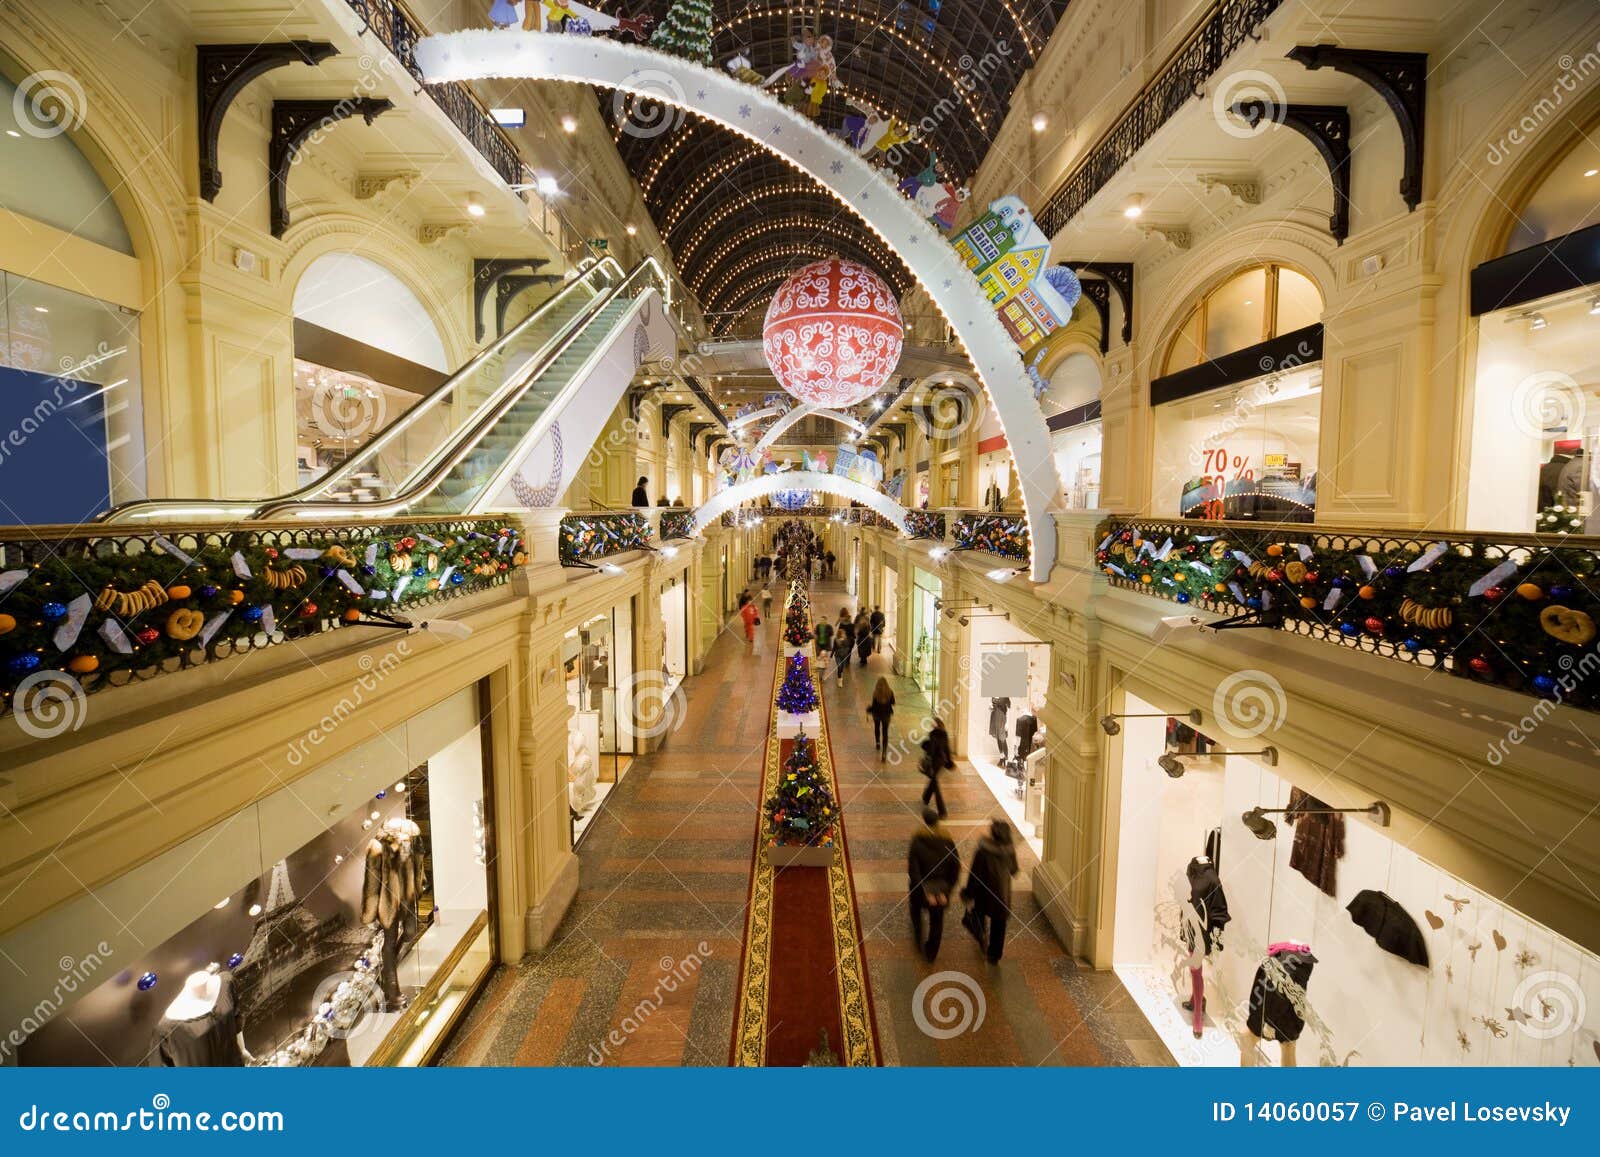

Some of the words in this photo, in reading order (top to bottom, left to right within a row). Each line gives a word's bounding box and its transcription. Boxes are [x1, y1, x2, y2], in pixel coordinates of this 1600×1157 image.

[1203, 449, 1227, 473] 70
[1233, 456, 1254, 483] %
[1200, 475, 1225, 499] 50
